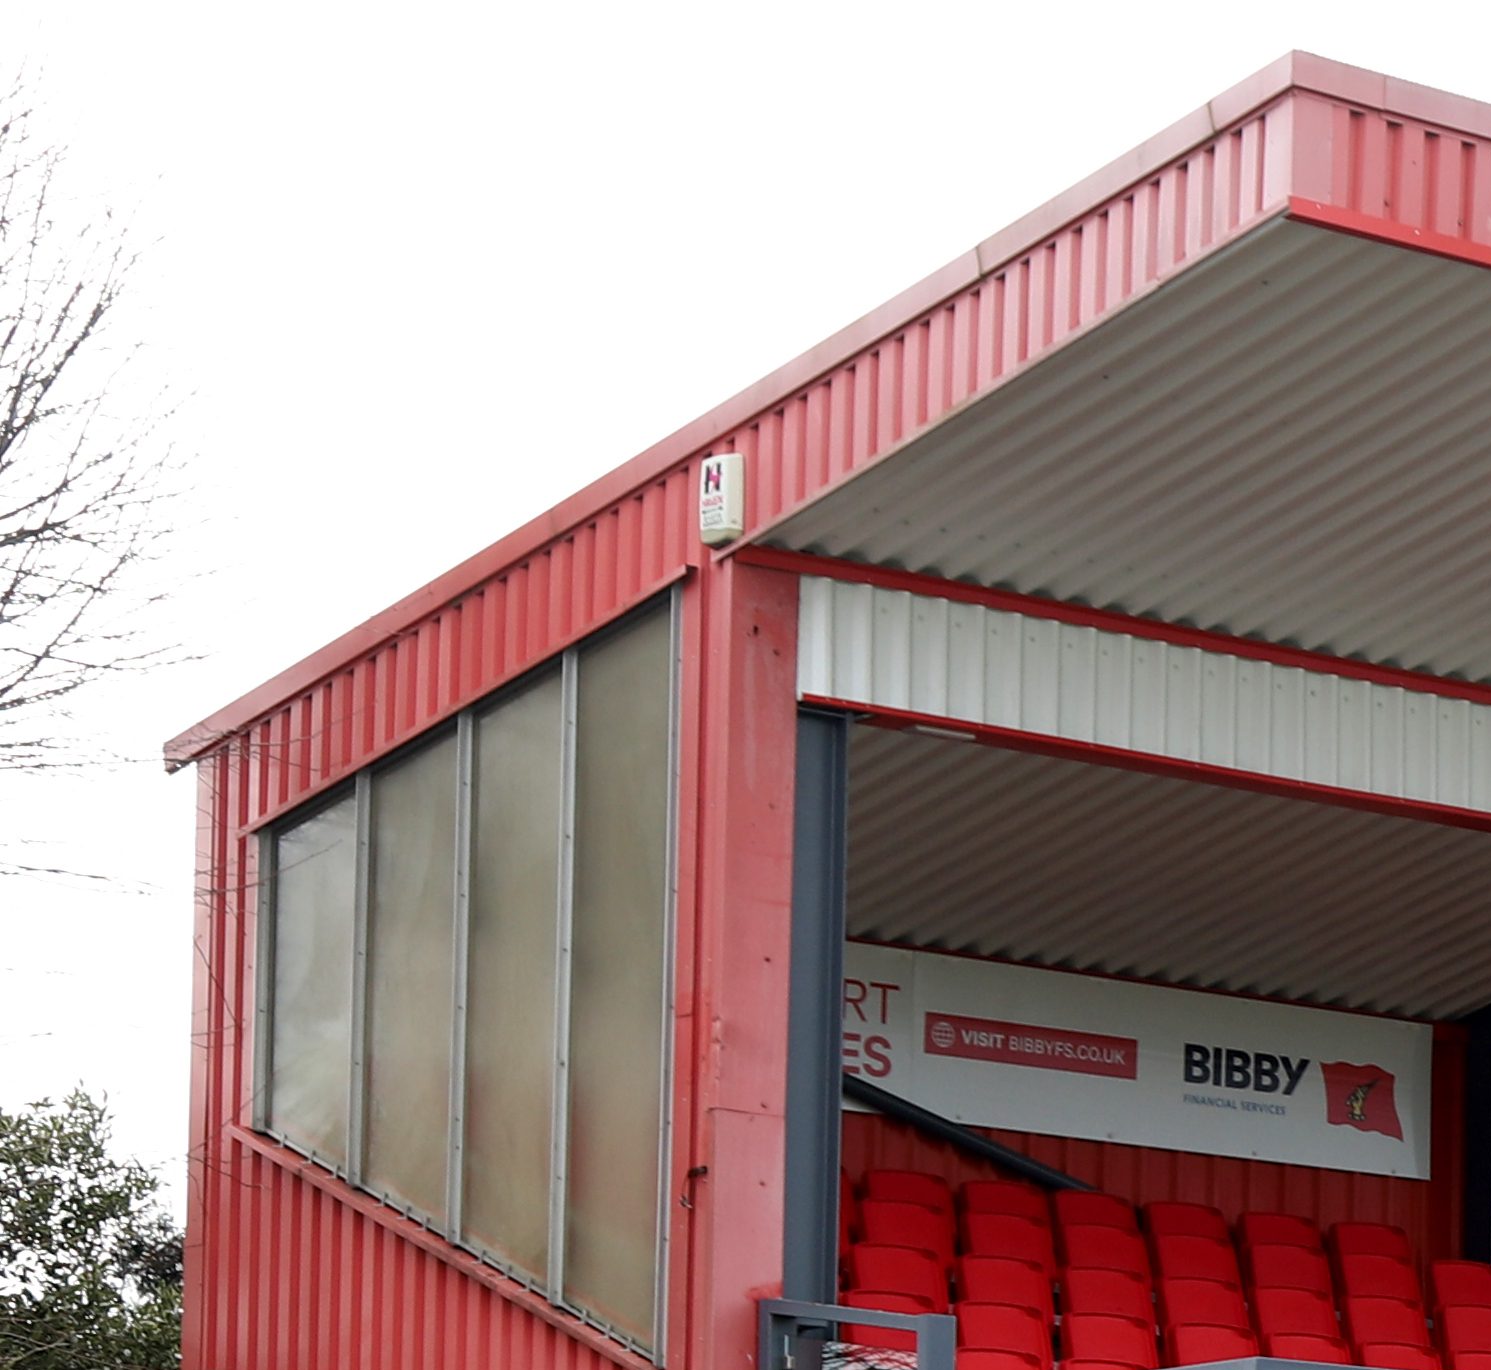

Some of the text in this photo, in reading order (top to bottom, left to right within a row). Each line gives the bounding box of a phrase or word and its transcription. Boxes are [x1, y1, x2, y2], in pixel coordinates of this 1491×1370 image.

[961, 1029, 1125, 1066] VISIT BIBBYFS.CO.UK
[1184, 1043, 1309, 1096] BIBBY
